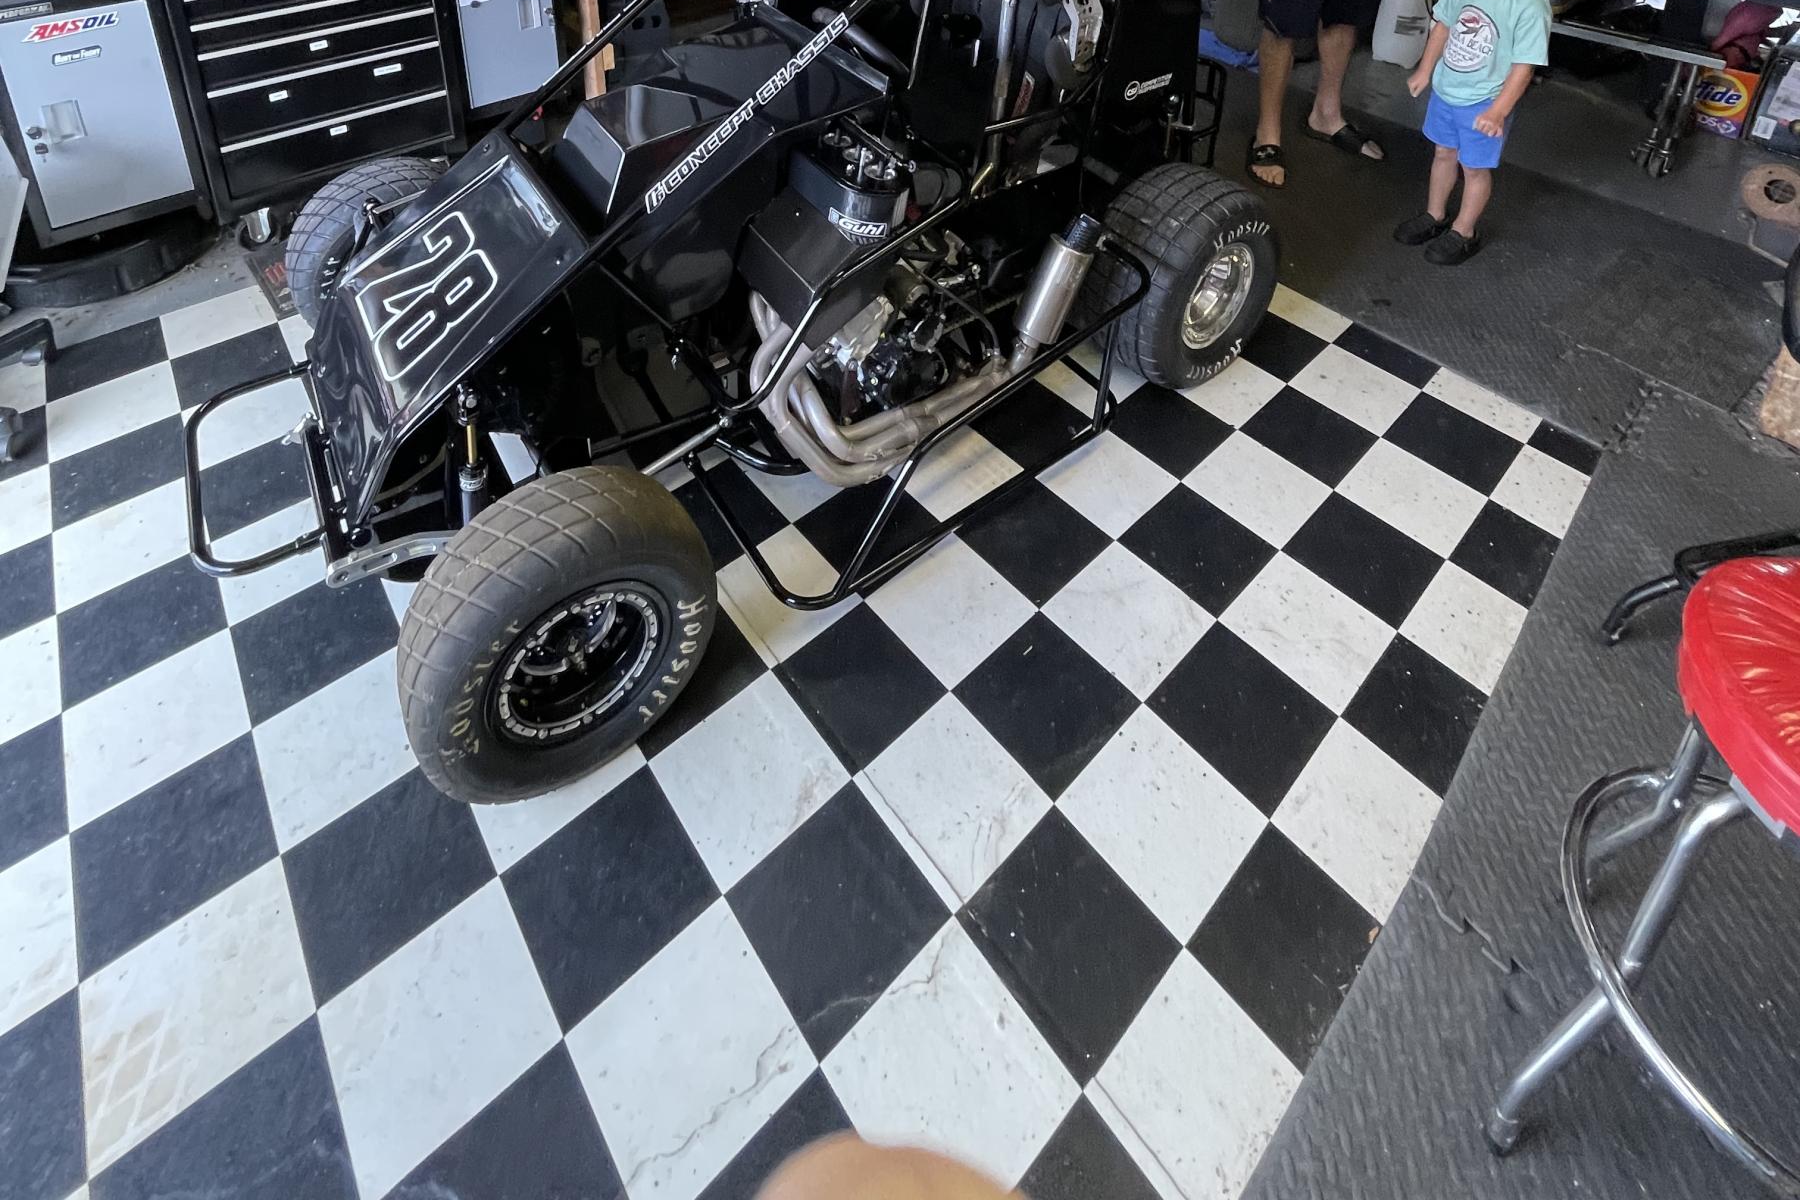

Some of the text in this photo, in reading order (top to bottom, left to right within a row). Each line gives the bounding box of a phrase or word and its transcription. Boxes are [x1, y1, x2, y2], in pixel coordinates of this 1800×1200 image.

[28, 13, 117, 40] AMSOIL
[756, 11, 849, 106] CHASSIS
[838, 217, 885, 235] Guhl
[354, 210, 498, 382] 28
